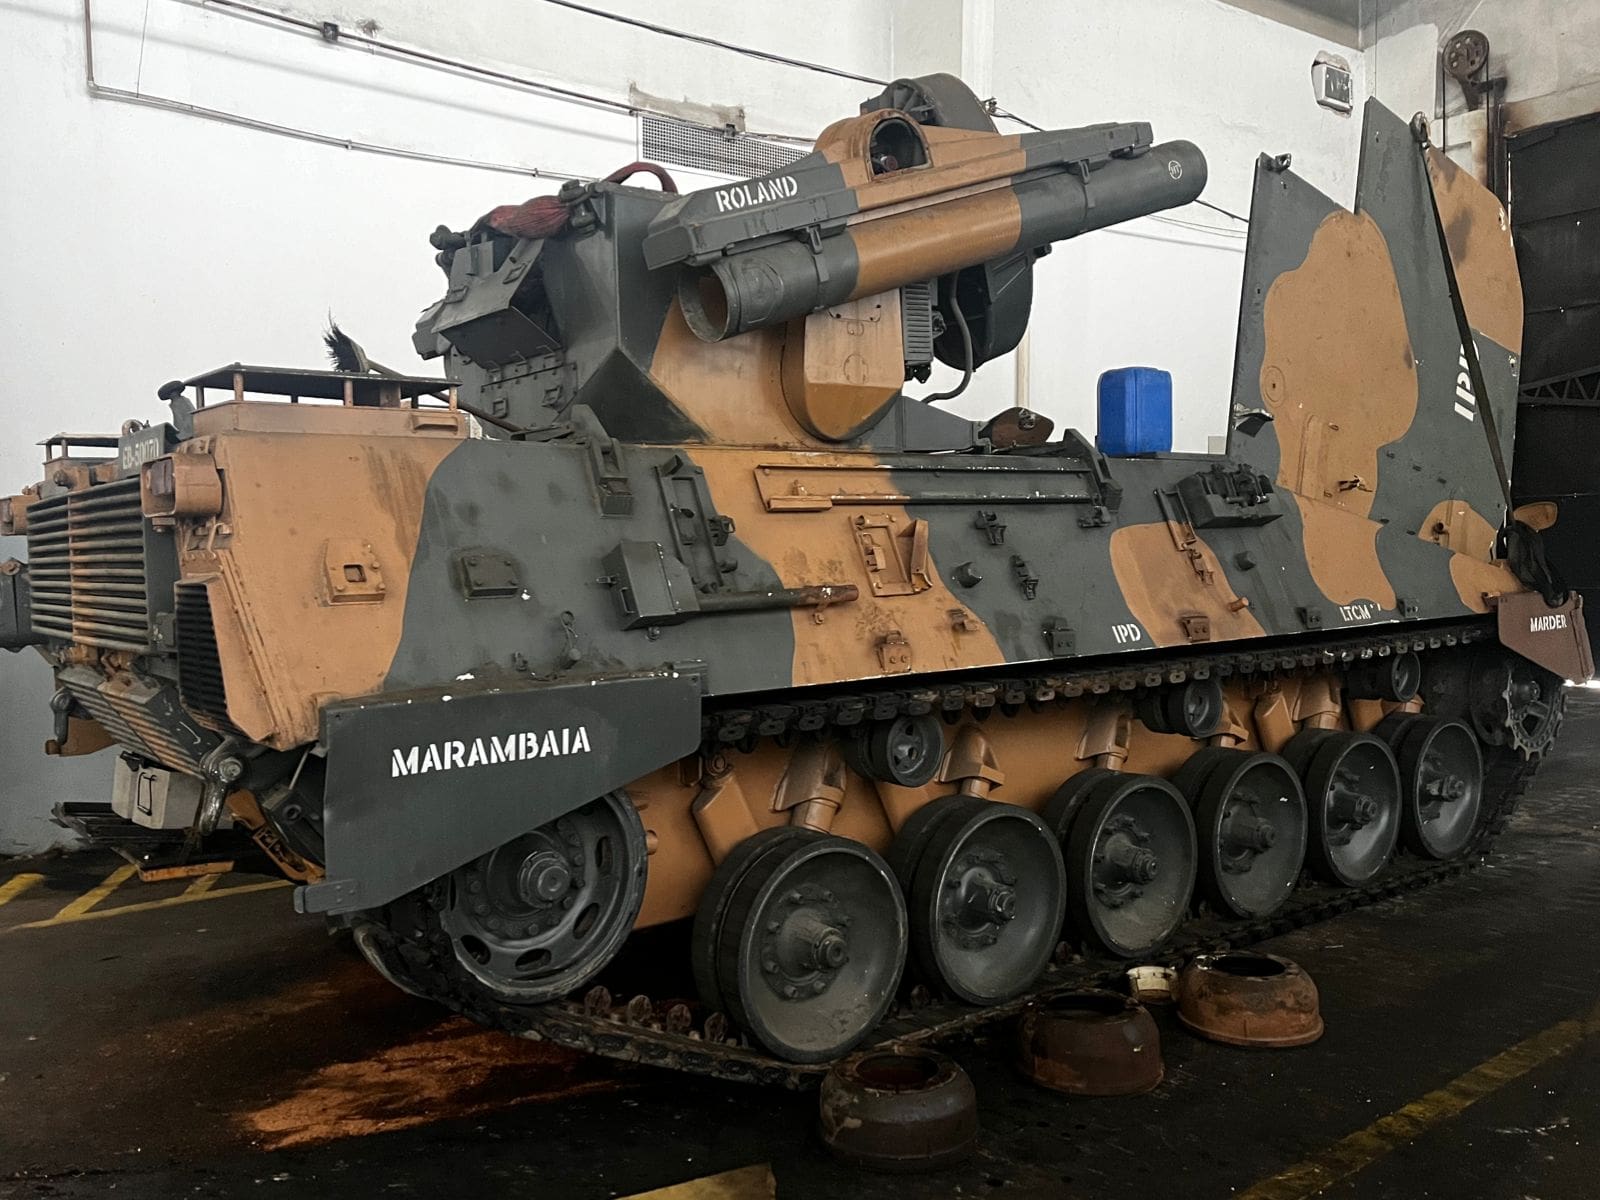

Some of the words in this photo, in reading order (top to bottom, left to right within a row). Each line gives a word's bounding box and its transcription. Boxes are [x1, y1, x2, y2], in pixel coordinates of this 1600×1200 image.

[715, 175, 798, 212] ROLAND
[1111, 623, 1141, 644] IPD
[1530, 614, 1568, 633] MARDER
[391, 726, 591, 777] MARAMBAIA
